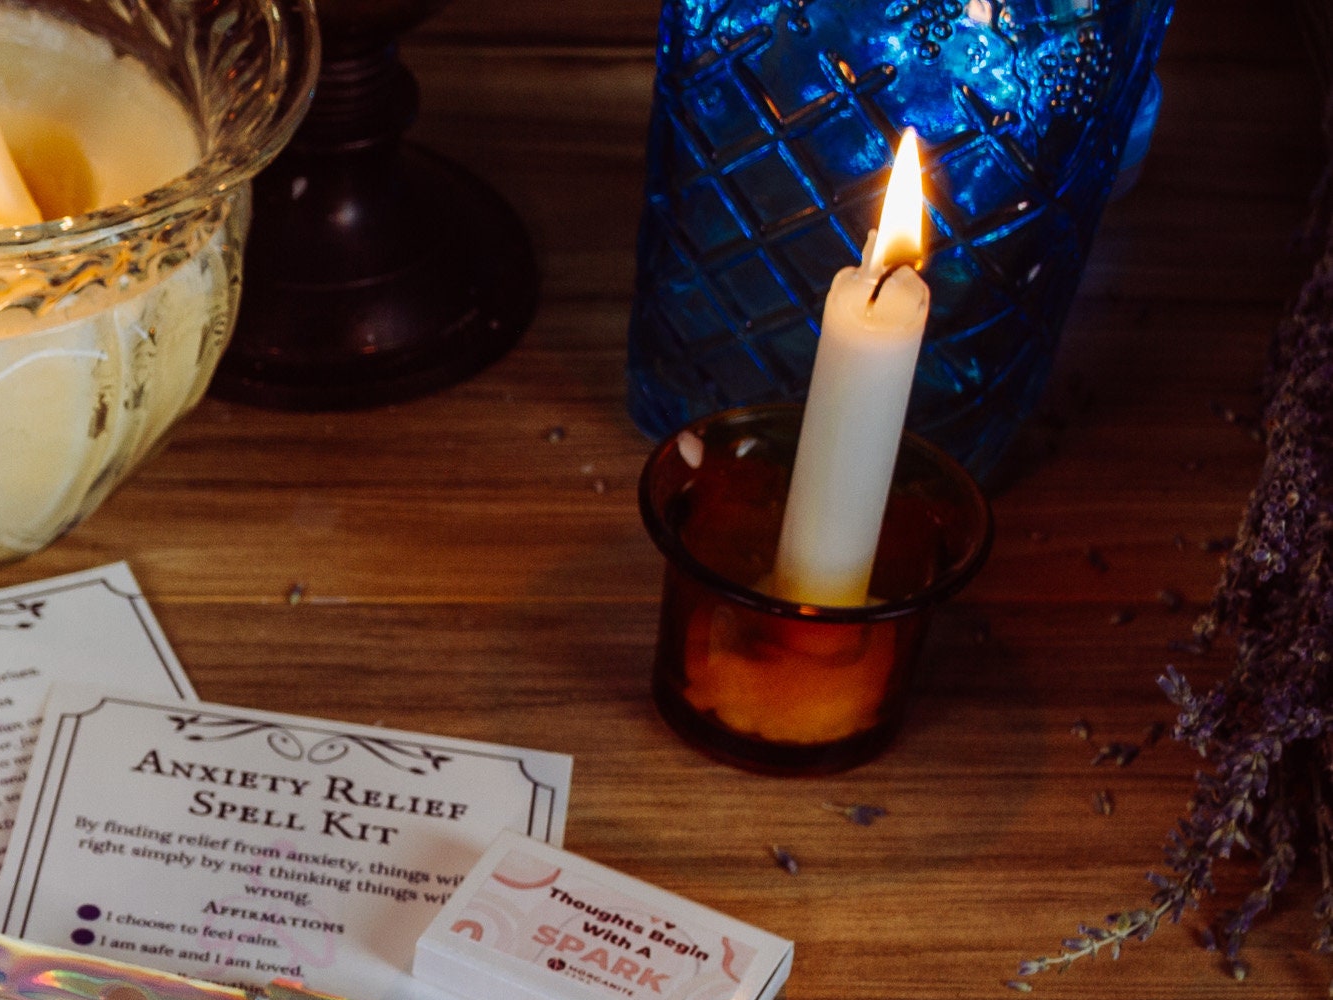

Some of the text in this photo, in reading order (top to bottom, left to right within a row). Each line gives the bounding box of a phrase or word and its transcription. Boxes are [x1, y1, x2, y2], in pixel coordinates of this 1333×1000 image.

[131, 748, 468, 820] ANXIETY RELIEF
[188, 789, 399, 846] SPELL KIT
[75, 815, 430, 886] By finding relief from anxiety, things
[78, 836, 417, 903] right simply by not thinking things
[201, 899, 346, 935] AFFIRMATIONS
[244, 882, 312, 906] wrong.
[117, 912, 177, 934] choose
[180, 922, 199, 935] to
[202, 924, 234, 941] feel
[237, 931, 280, 948] calm.
[547, 886, 710, 962] Thoughts Begin
[582, 921, 652, 959] With A
[110, 938, 136, 951] am
[139, 941, 174, 956] safe
[178, 946, 211, 963] and
[224, 955, 251, 969] am
[255, 959, 305, 978] loved.
[531, 923, 671, 994] SPARK
[568, 964, 636, 997] MORGANITE
